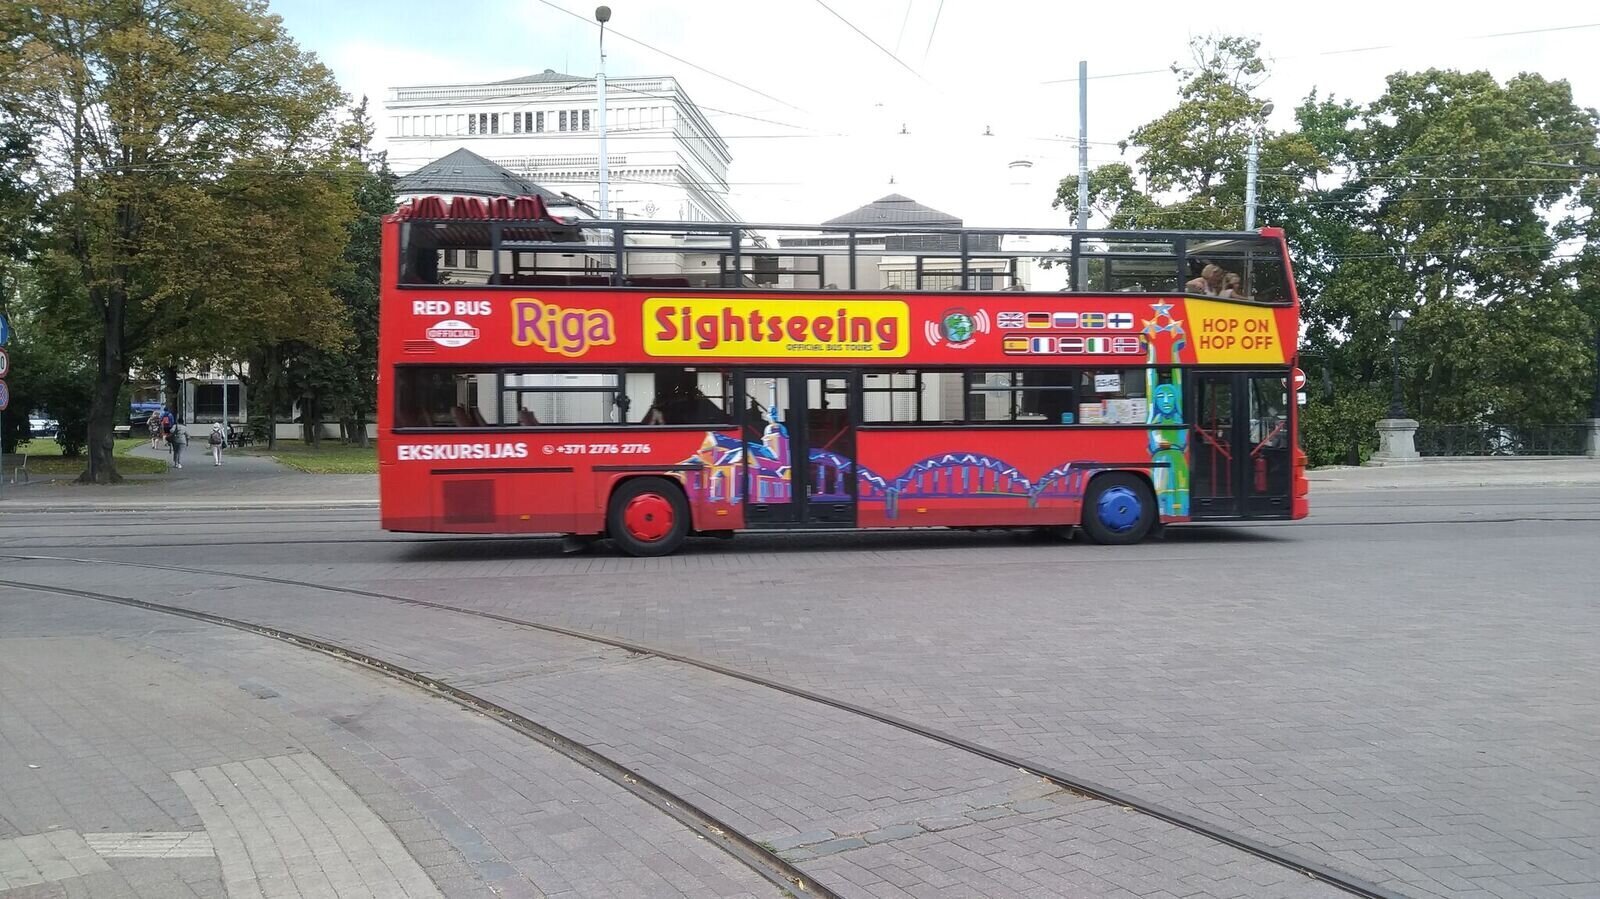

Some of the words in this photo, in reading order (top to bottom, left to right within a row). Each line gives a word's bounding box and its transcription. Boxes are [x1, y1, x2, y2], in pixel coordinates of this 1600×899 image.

[412, 300, 451, 315] RED
[454, 300, 492, 315] BUS
[515, 302, 611, 353] Riga
[655, 306, 898, 351] Sightseeing
[1203, 319, 1238, 332] HOP
[1244, 319, 1269, 332] ON
[428, 329, 475, 338] OFFICIAL
[1200, 336, 1236, 349] HOP
[1241, 336, 1273, 349] OFF
[397, 442, 528, 460] EKSKURSIJAS
[556, 444, 586, 454] +371
[588, 444, 619, 454] 2776
[621, 444, 651, 454] 2776
